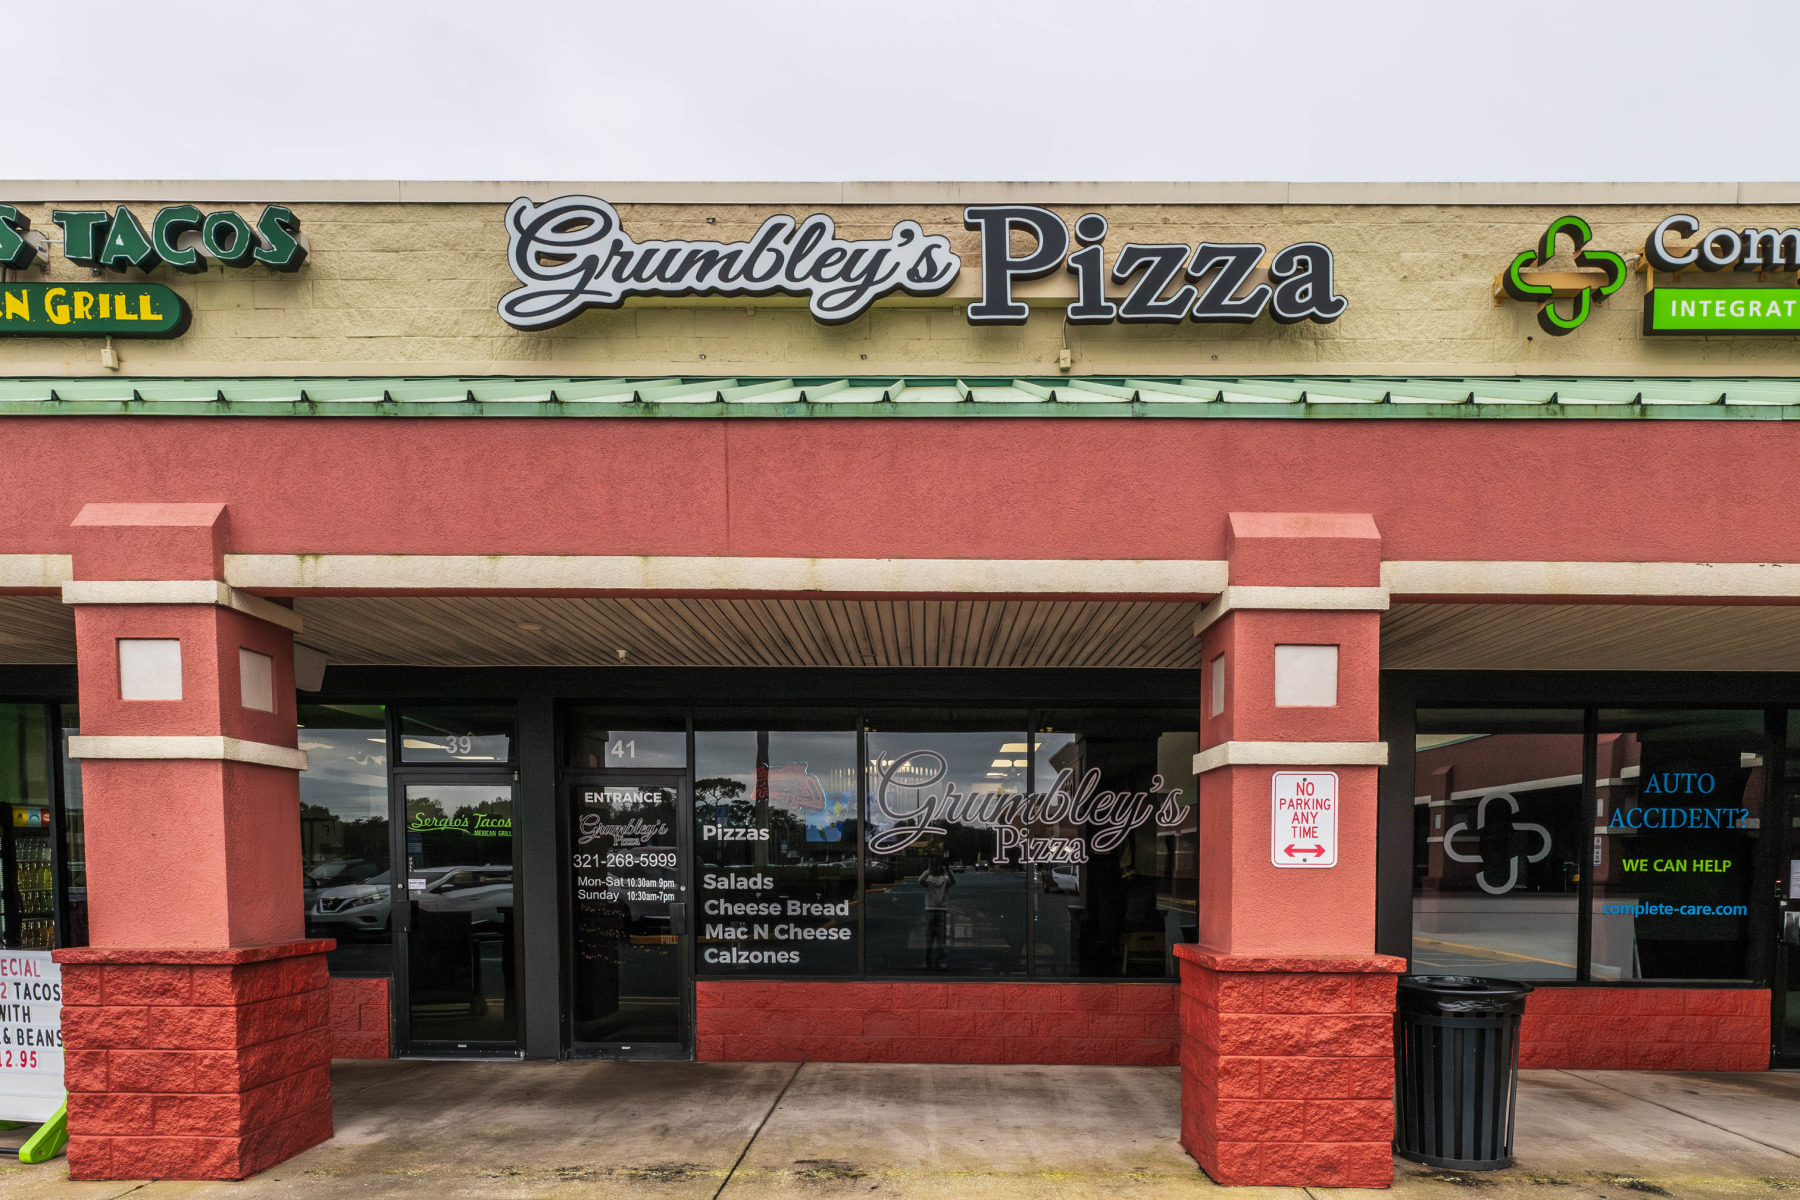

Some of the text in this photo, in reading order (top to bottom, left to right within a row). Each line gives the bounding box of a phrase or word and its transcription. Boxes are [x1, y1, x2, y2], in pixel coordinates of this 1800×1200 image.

[52, 204, 302, 269] TACOS
[1650, 213, 1800, 267] Com
[499, 196, 1348, 324] Grumbley's Pizza
[45, 287, 163, 324] GRILL
[1671, 300, 1797, 317] INTEGRAT
[446, 735, 472, 754] 39
[611, 739, 636, 759] 41
[1296, 782, 1315, 796] NO
[1644, 773, 1715, 794] AUTO
[584, 792, 662, 803] ENTRANCE
[869, 750, 1190, 854] Grumbley's
[1279, 798, 1331, 810] PARKING
[411, 812, 512, 830] Sergio's Tacos
[1291, 811, 1318, 824] ANY
[1608, 807, 1750, 829] ACCIDENT?
[578, 813, 669, 844] Grumbley's
[703, 823, 770, 841] Pizzas
[1291, 826, 1319, 838] TIME
[993, 825, 1089, 864] Pizza
[573, 853, 677, 868] 321-268-5999
[1622, 859, 1732, 873] WE CAN HELP
[578, 876, 624, 887] Mon-Sat
[703, 873, 774, 890] Salads
[578, 889, 675, 903] Sunday 10:30am-7pm
[704, 899, 849, 916] Cheese Bread
[1603, 902, 1747, 918] complete-care.com
[705, 923, 851, 940] Mac N Cheese
[704, 947, 800, 964] Calzones
[0, 958, 41, 977] ECIAL
[13, 982, 61, 1002] TACOS
[17, 1028, 63, 1047] BEANS
